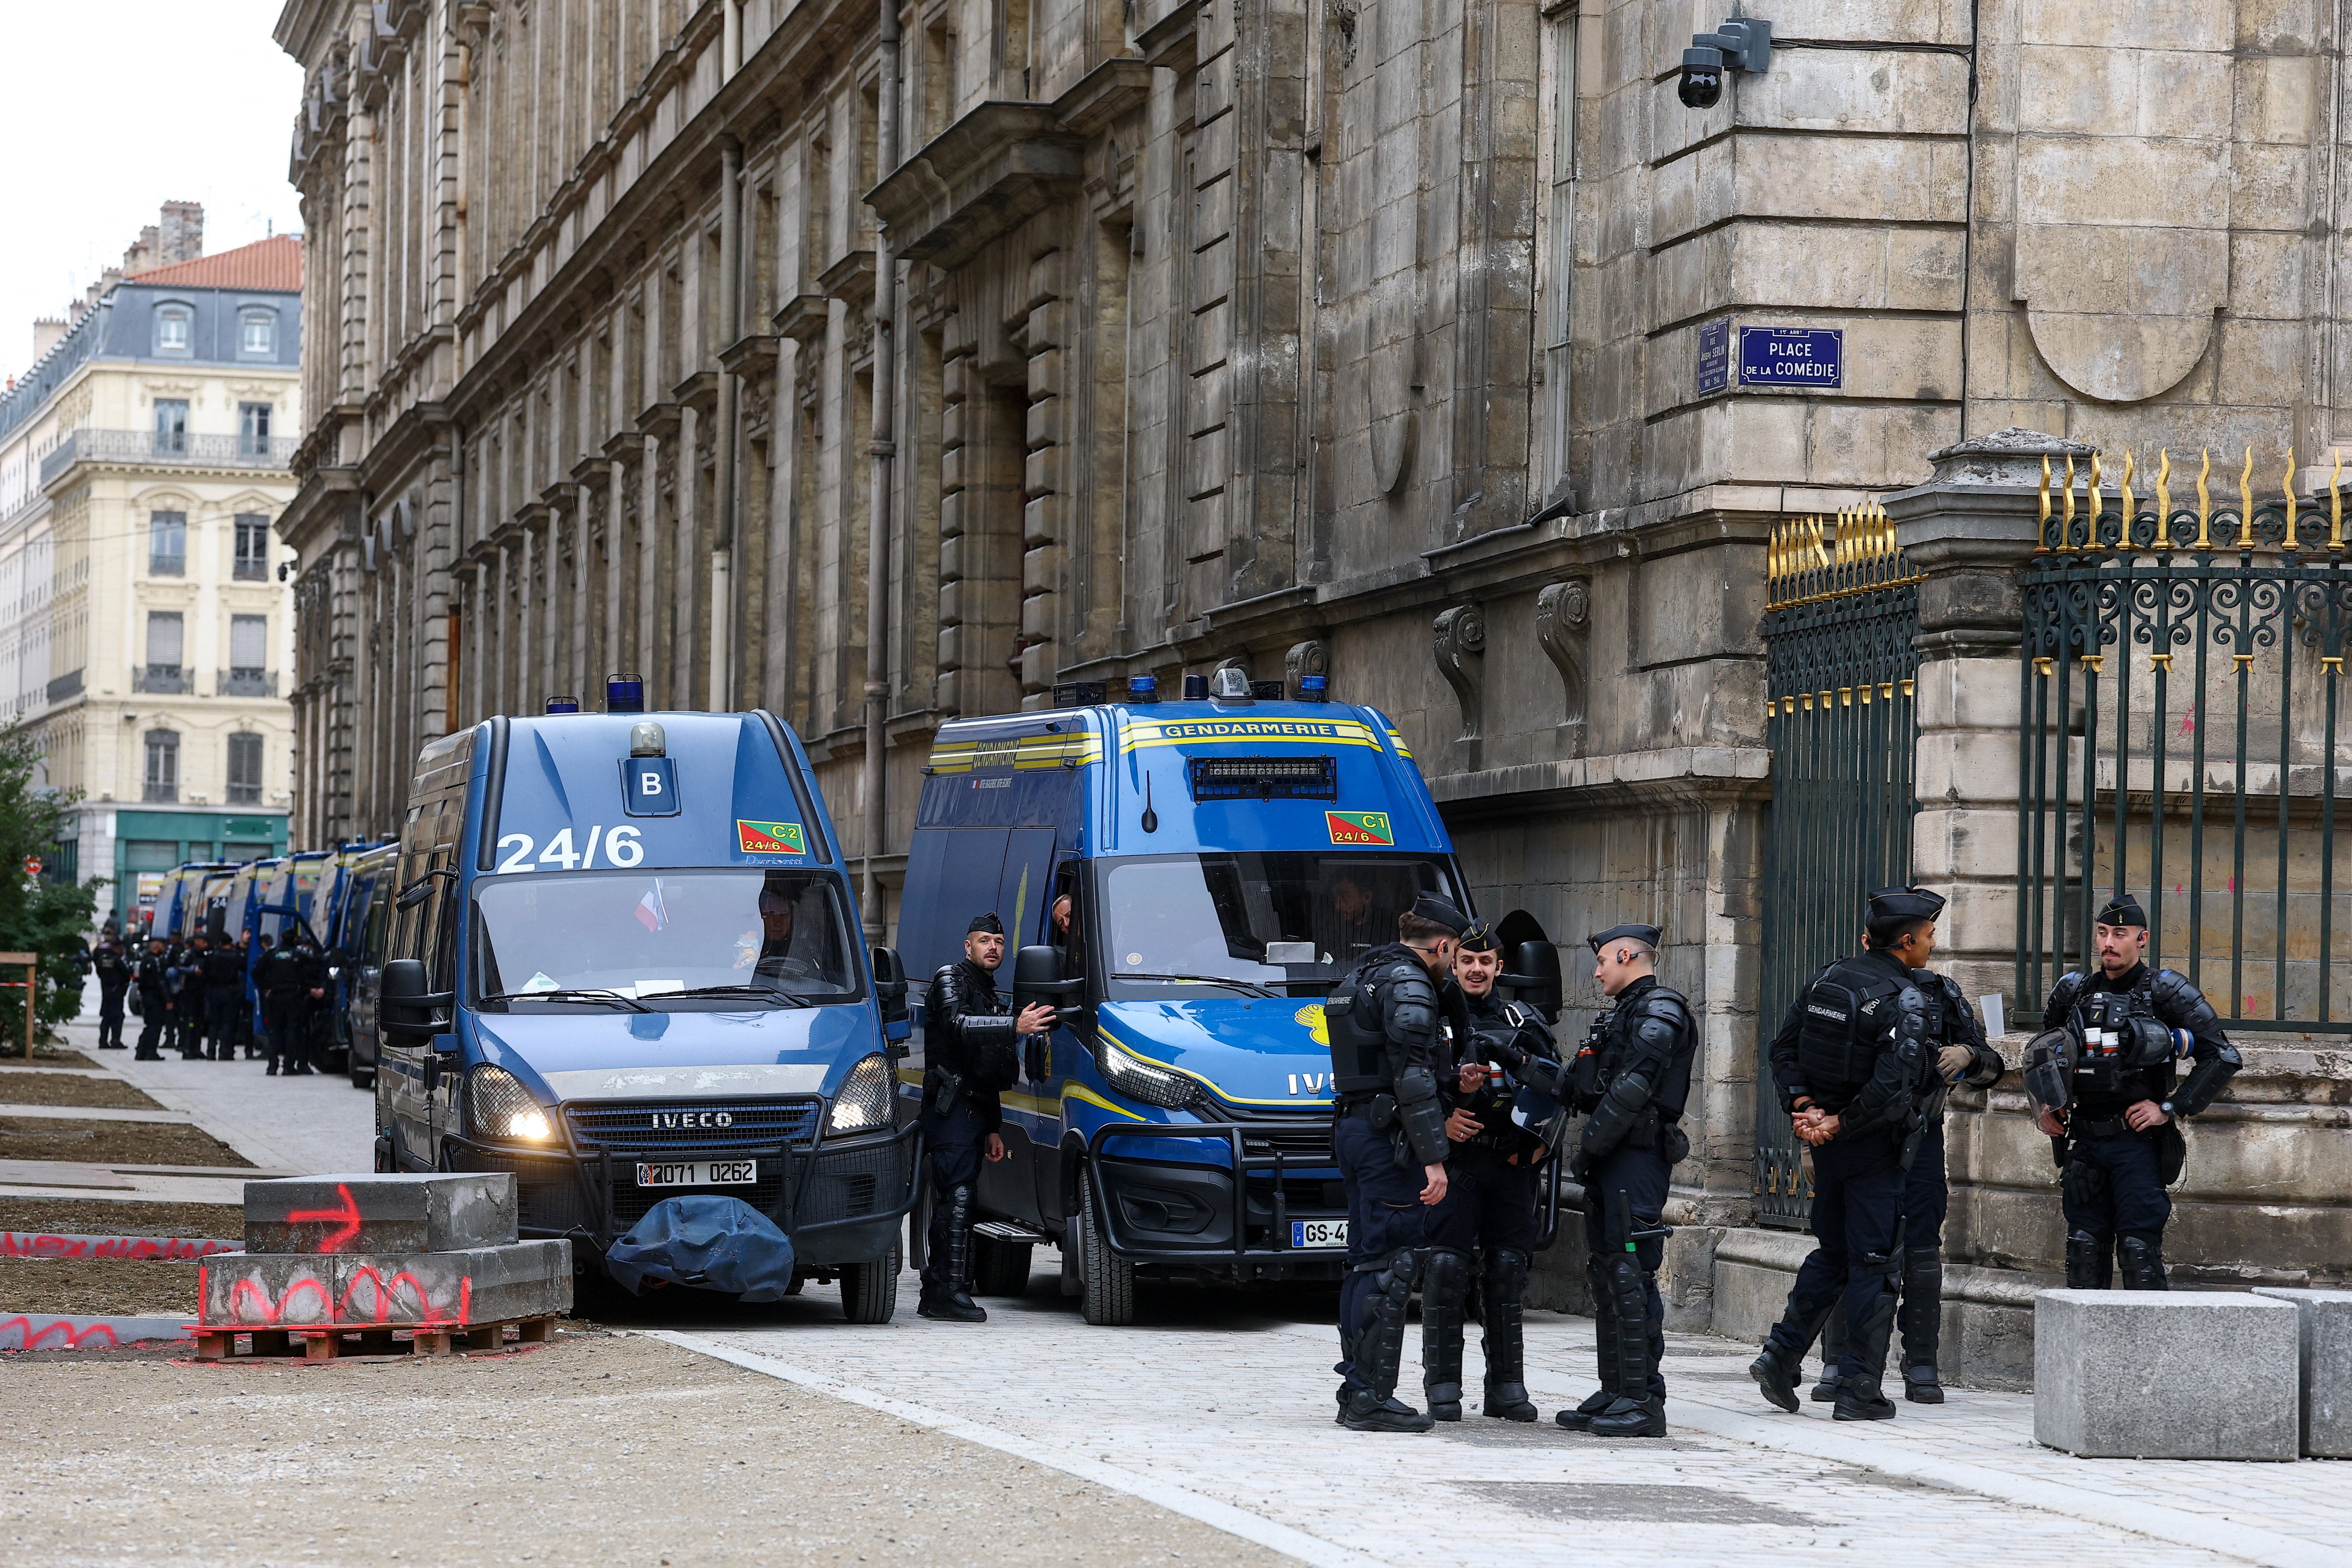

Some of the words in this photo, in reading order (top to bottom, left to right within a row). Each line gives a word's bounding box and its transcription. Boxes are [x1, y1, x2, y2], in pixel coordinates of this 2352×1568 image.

[1712, 344, 1725, 358] SERLIN
[1770, 343, 1812, 356] PLACE
[1746, 366, 1757, 375] DE
[1760, 367, 1771, 375] LA
[1776, 360, 1835, 377] COMÉDIE
[1166, 724, 1331, 737] GENDARMERIE
[974, 740, 1020, 769] GENDARMERIE
[641, 773, 662, 795] B
[1362, 815, 1386, 828] C1
[771, 825, 798, 838] C2
[1335, 832, 1369, 841] 24/6
[497, 825, 644, 874] 24/6
[745, 841, 781, 850] 24/6
[745, 855, 803, 865] Durisotti
[1326, 996, 1352, 1005] GENDARMERIE
[1808, 1005, 1847, 1021] GENDARMERIE
[653, 1112, 732, 1128] IVECO
[653, 1164, 694, 1183] 2071
[710, 1163, 753, 1182] 0262
[1306, 1224, 1349, 1242] GS-4
